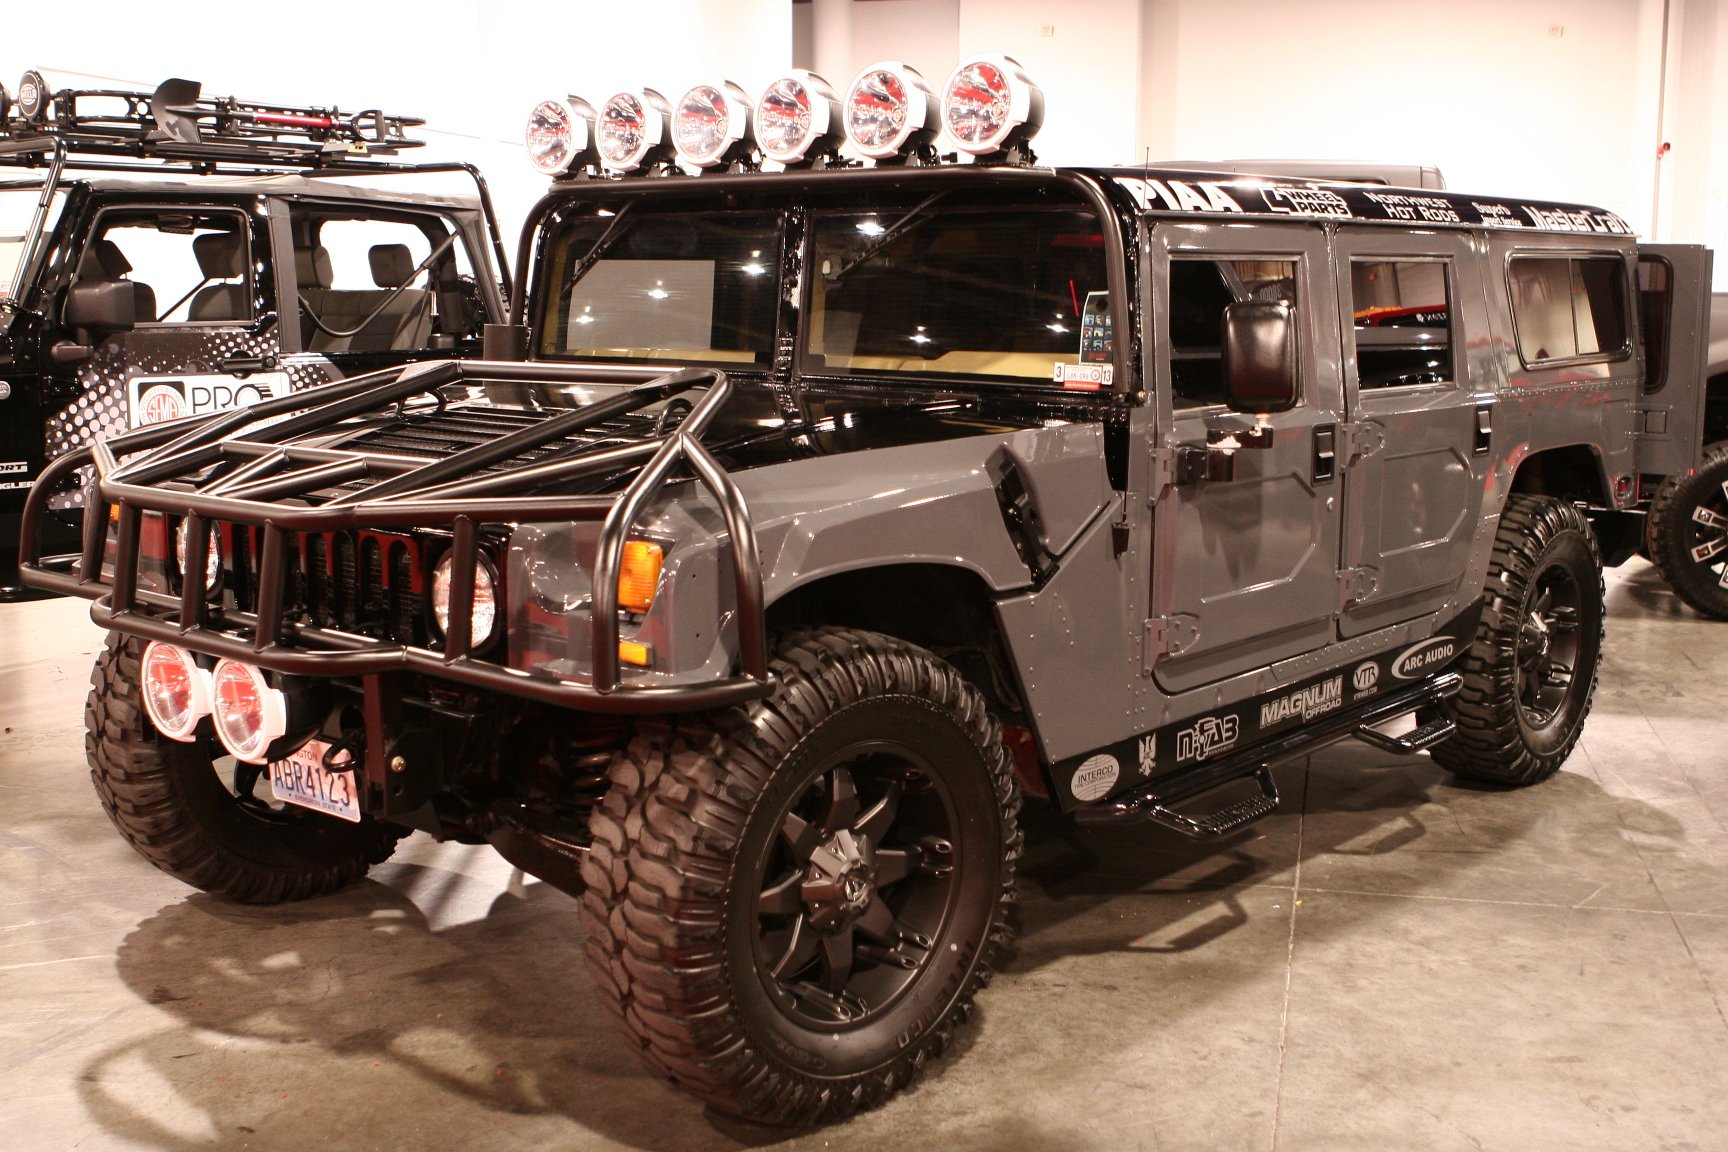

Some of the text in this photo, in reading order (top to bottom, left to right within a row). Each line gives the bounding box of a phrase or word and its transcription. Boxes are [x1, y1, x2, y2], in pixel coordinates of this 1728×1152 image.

[1113, 177, 1243, 212] PIAA
[1286, 190, 1343, 203] WHEEL
[1362, 191, 1453, 209] NORTHWEST
[1295, 201, 1350, 216] PARTS
[1382, 203, 1460, 222] HOT RODS
[1056, 366, 1062, 378] 3
[1103, 369, 1112, 382] 13
[147, 395, 178, 423] SEMA
[192, 383, 266, 415] PRO
[1403, 643, 1454, 672] ARC AUDIO
[1259, 675, 1343, 729] MAGNUM
[1305, 698, 1342, 719] OFFROAD
[274, 758, 350, 807] ABR4123
[1078, 764, 1114, 783] INTERCO
